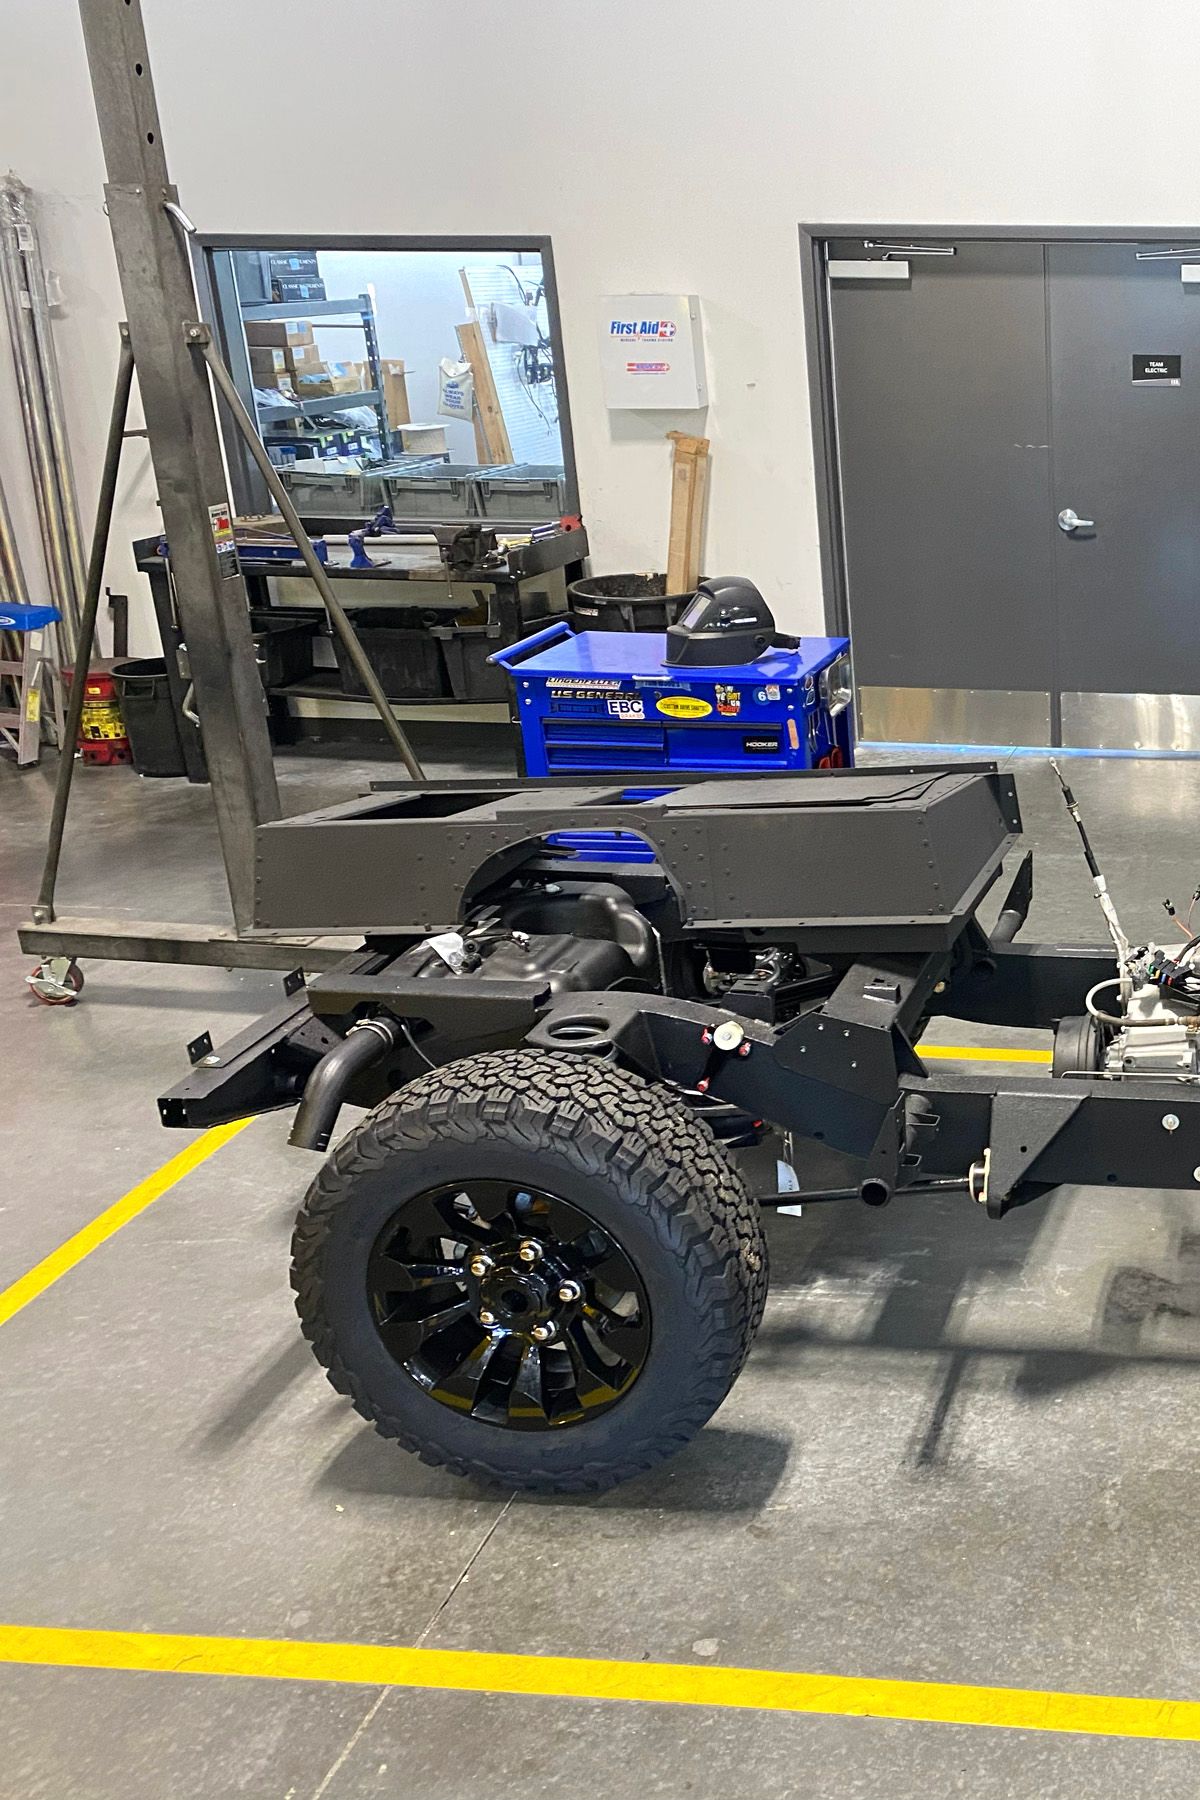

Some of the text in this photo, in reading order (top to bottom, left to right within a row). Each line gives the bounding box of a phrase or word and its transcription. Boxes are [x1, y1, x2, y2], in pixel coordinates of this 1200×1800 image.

[610, 321, 659, 334] First Aid
[551, 690, 642, 700] US GENERAL
[609, 700, 643, 714] EBC
